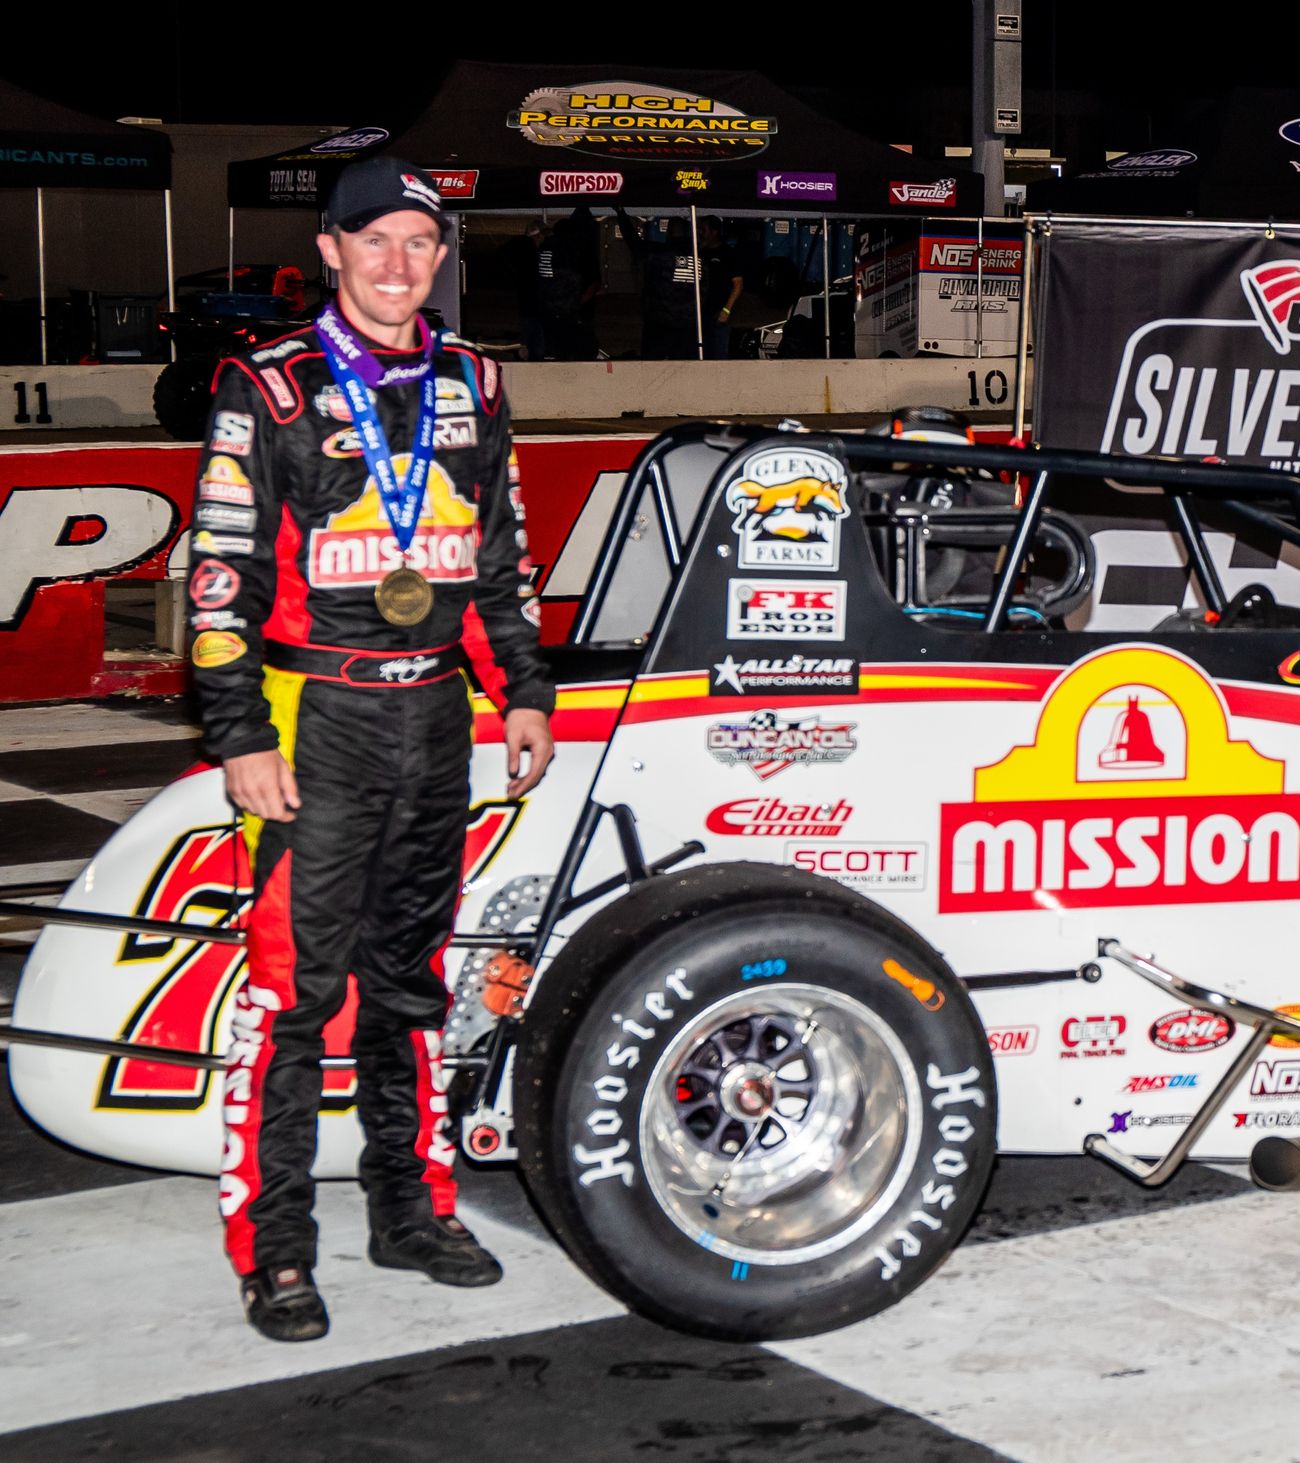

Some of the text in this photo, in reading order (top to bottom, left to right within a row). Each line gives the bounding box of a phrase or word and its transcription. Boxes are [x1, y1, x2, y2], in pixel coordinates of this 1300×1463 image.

[569, 94, 714, 112] HIGH
[519, 111, 770, 131] PERFORMANCE
[537, 133, 767, 145] LUBRICANTS
[270, 169, 318, 192] TOTAL SEAL
[544, 173, 619, 193] SIMPSON
[675, 170, 703, 181] SUPER
[780, 180, 834, 191] HOOSIER
[929, 243, 1022, 267] NOS ENERG
[981, 258, 1017, 269] DRINK
[967, 370, 1009, 406] 10
[14, 381, 53, 425] 11
[755, 546, 824, 561] FARMS
[747, 590, 834, 609] FK
[761, 611, 834, 620] ROD
[739, 623, 834, 633] ENDS
[738, 658, 855, 674] ALLSTAR
[739, 675, 853, 687] PERFORMANCE
[708, 729, 814, 750] DUNCAN
[705, 797, 854, 837] Eibach
[794, 851, 919, 873] SCOTT
[1166, 1019, 1220, 1040] DMI
[573, 967, 695, 1190] Hoosier
[1122, 1073, 1200, 1094] AMSOIL
[873, 1062, 986, 1282] Hoosier
